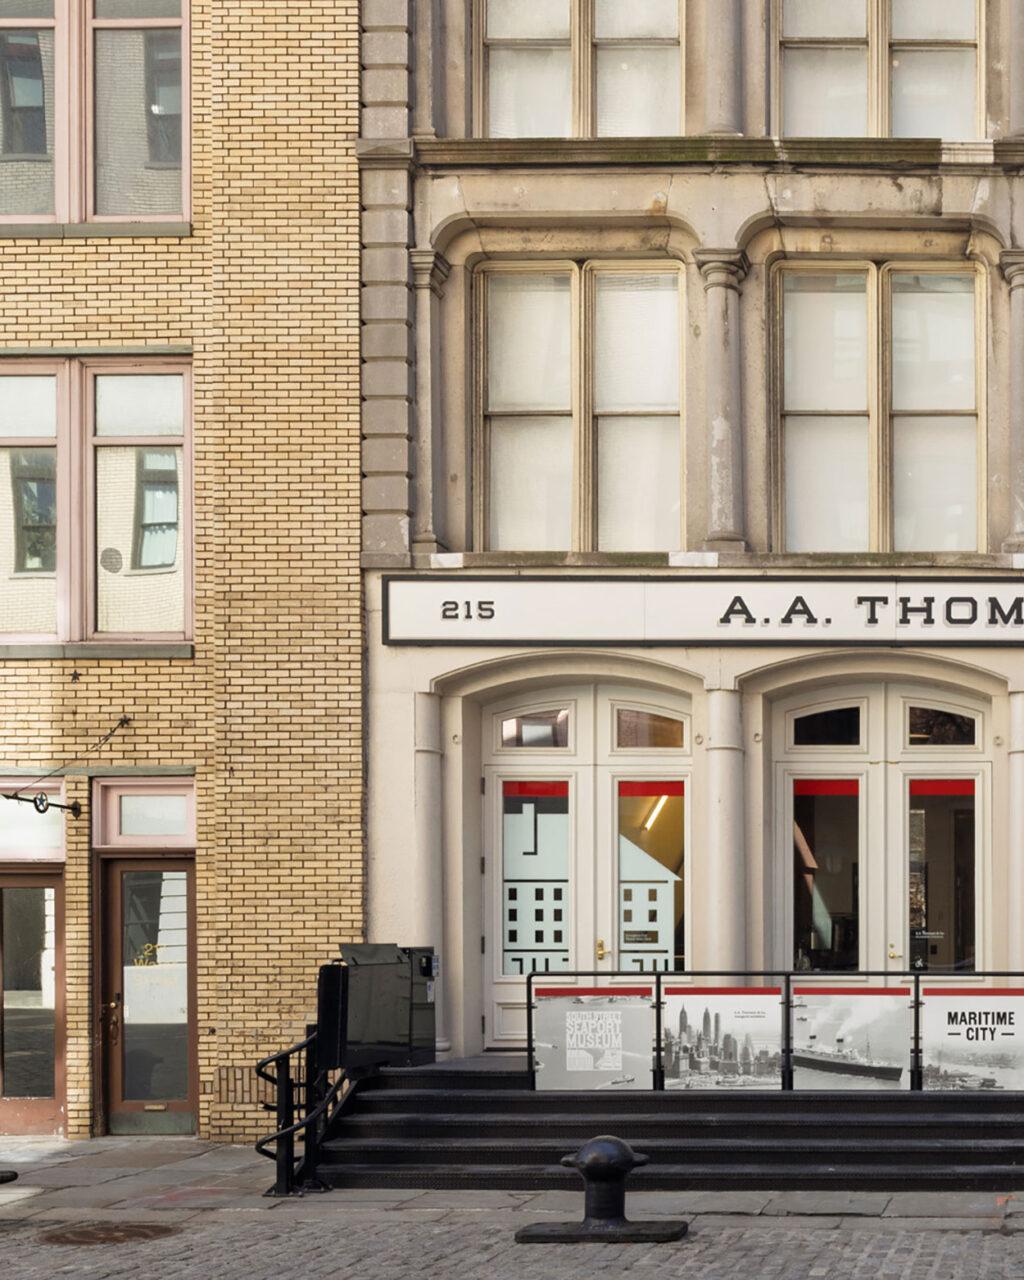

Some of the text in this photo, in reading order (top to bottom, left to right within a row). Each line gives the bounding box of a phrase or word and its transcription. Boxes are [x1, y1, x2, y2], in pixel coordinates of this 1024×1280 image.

[441, 601, 496, 620] 215
[719, 596, 832, 624] A.A.
[947, 1011, 1015, 1026] MARITIME
[566, 1021, 621, 1035] SEAPORT
[966, 1027, 997, 1041] CITY
[566, 1033, 622, 1049] MUSEUM
